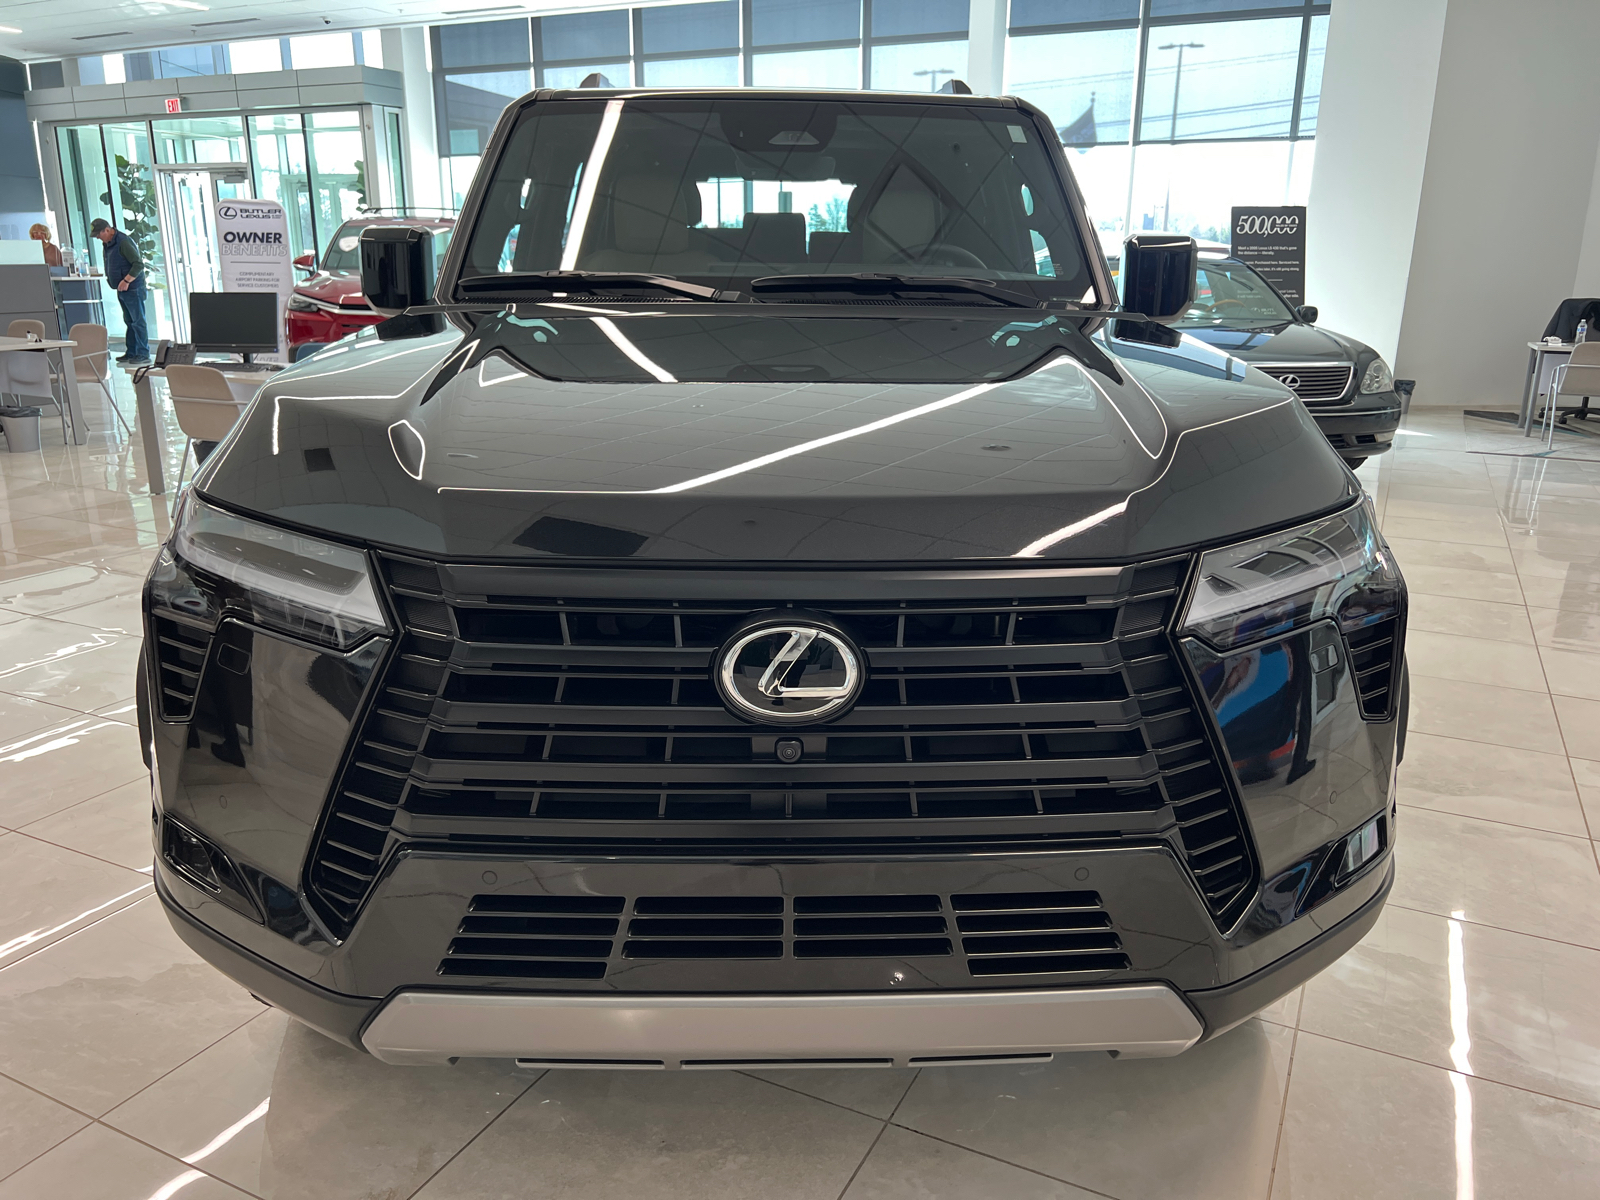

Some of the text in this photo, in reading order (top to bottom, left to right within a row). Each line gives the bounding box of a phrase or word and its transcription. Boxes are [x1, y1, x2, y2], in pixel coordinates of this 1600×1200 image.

[167, 99, 180, 113] EXIT
[223, 231, 283, 244] OWNER
[221, 243, 288, 257] BENEFITS
